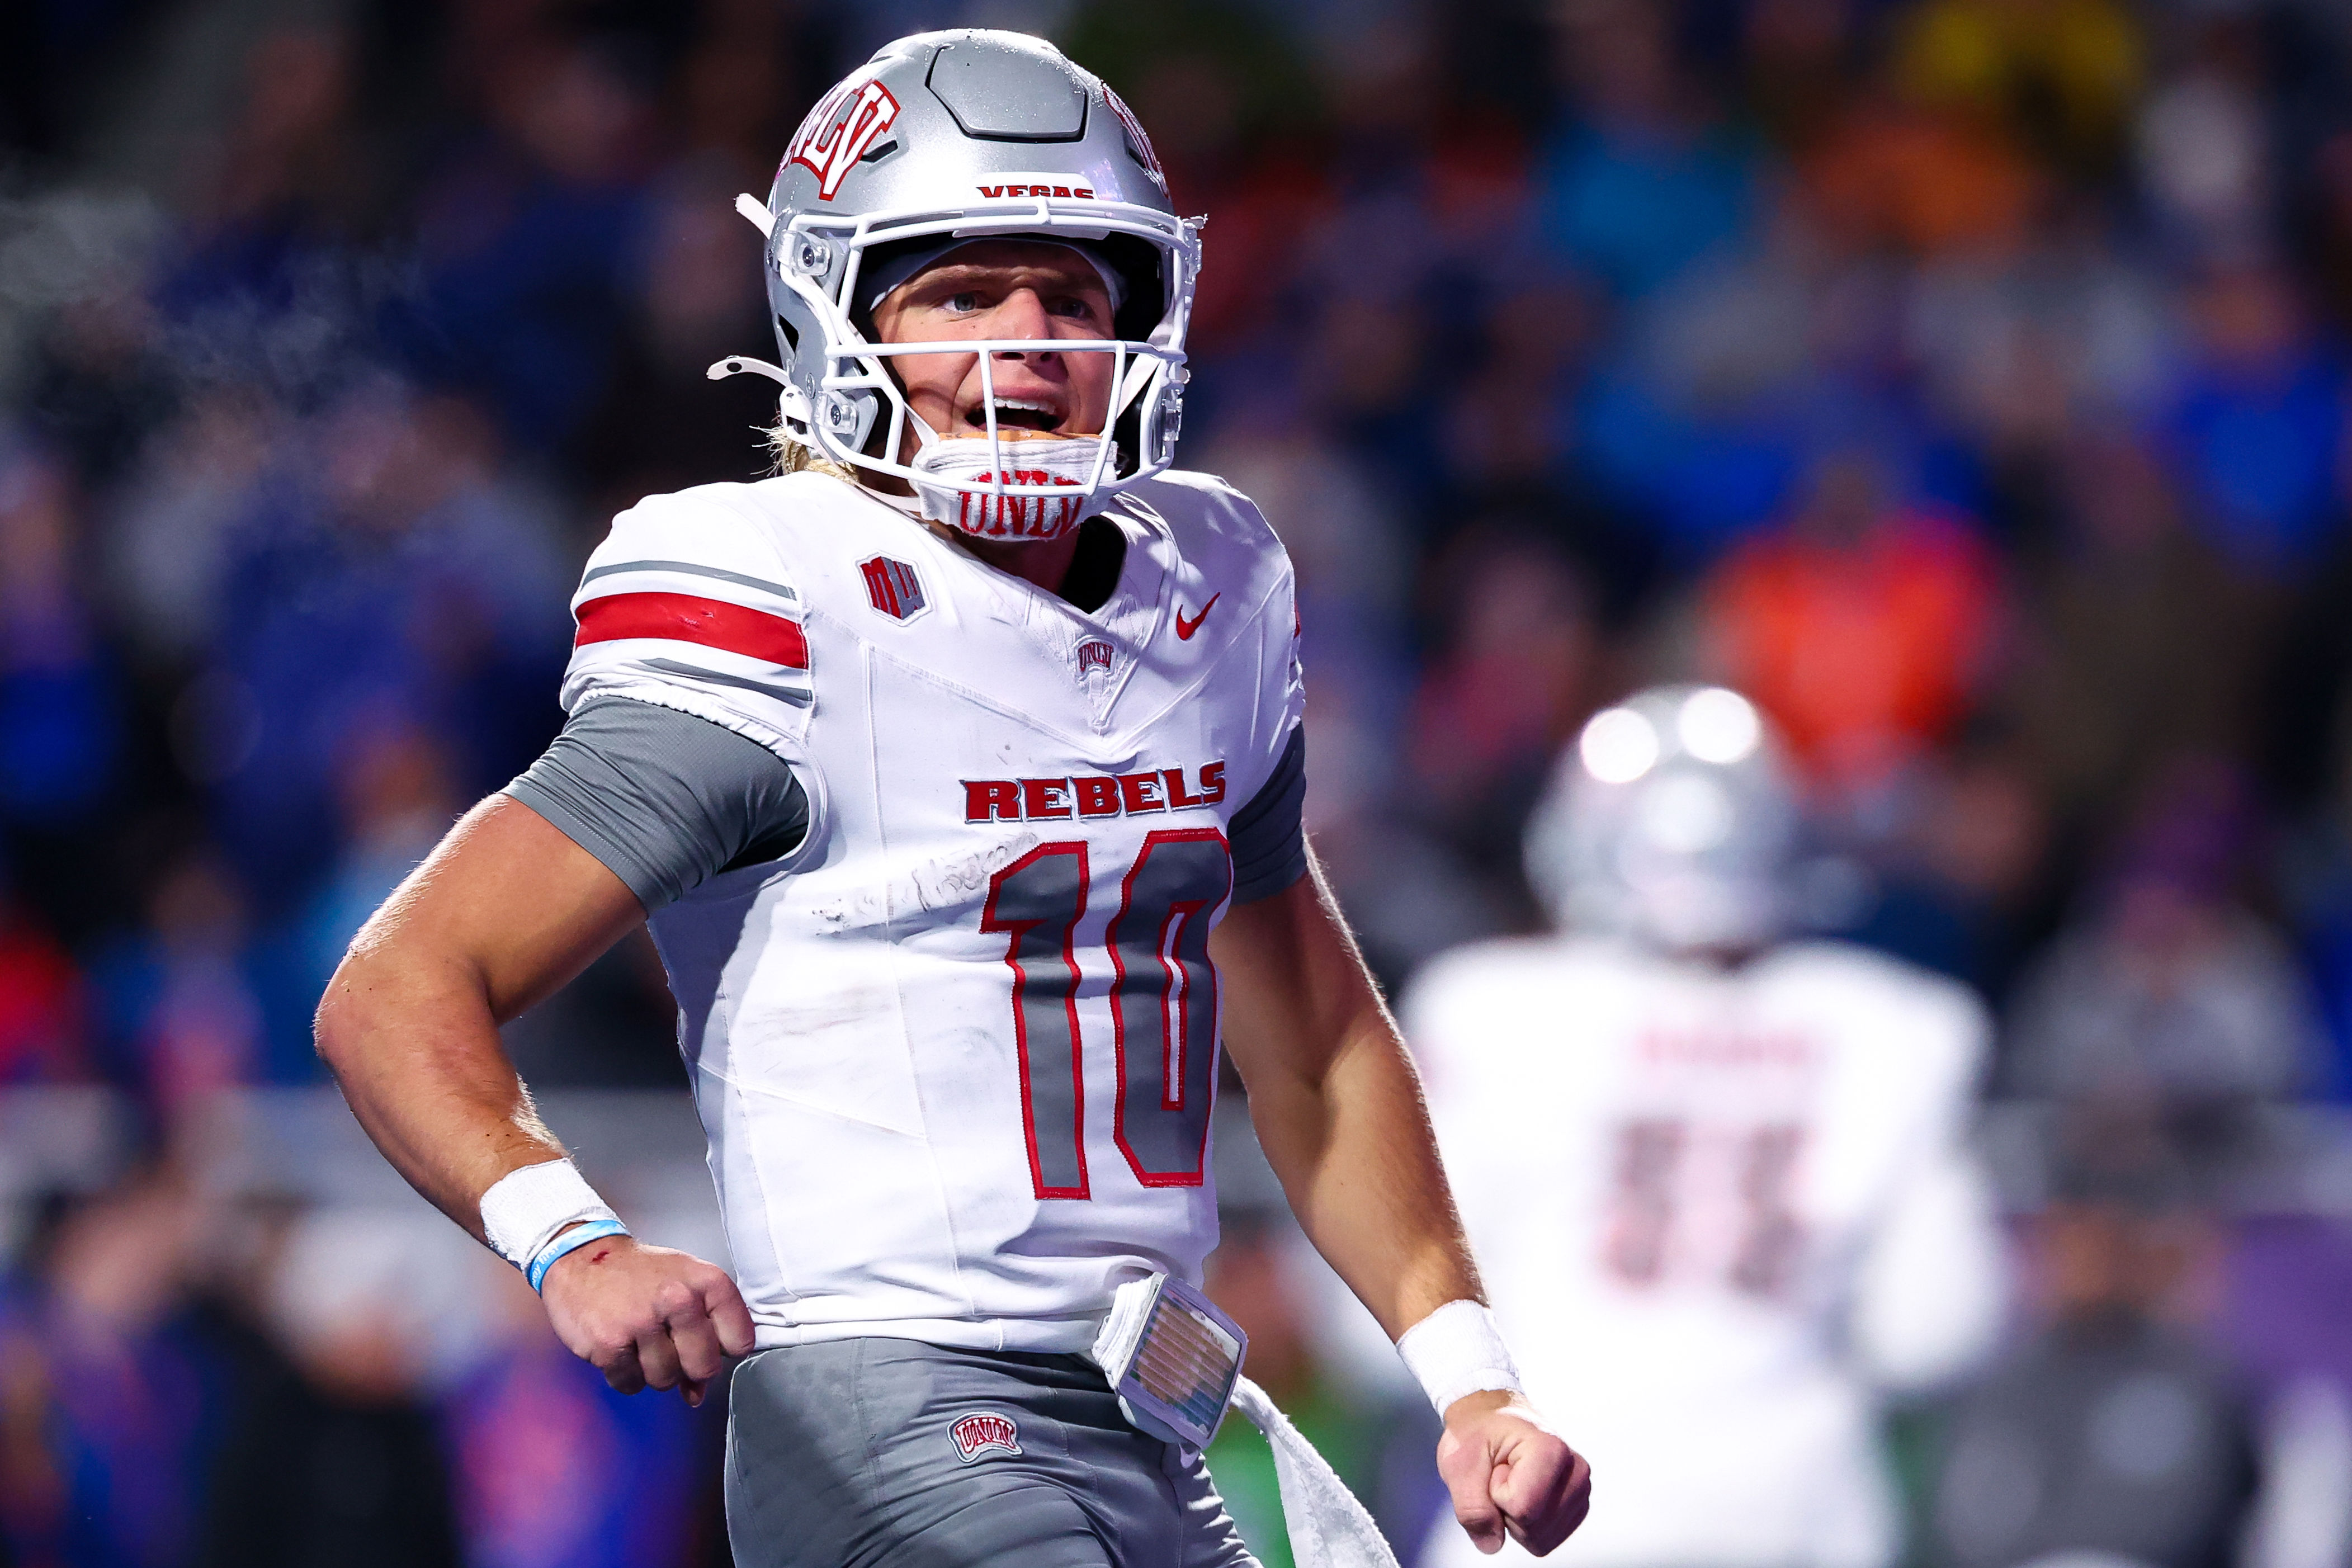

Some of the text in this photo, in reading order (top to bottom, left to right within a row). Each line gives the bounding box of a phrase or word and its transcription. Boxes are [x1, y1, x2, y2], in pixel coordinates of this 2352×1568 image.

[959, 759, 1226, 824] REBELS
[980, 826, 1230, 1201] 10
[955, 1417, 1016, 1454] UNLV
